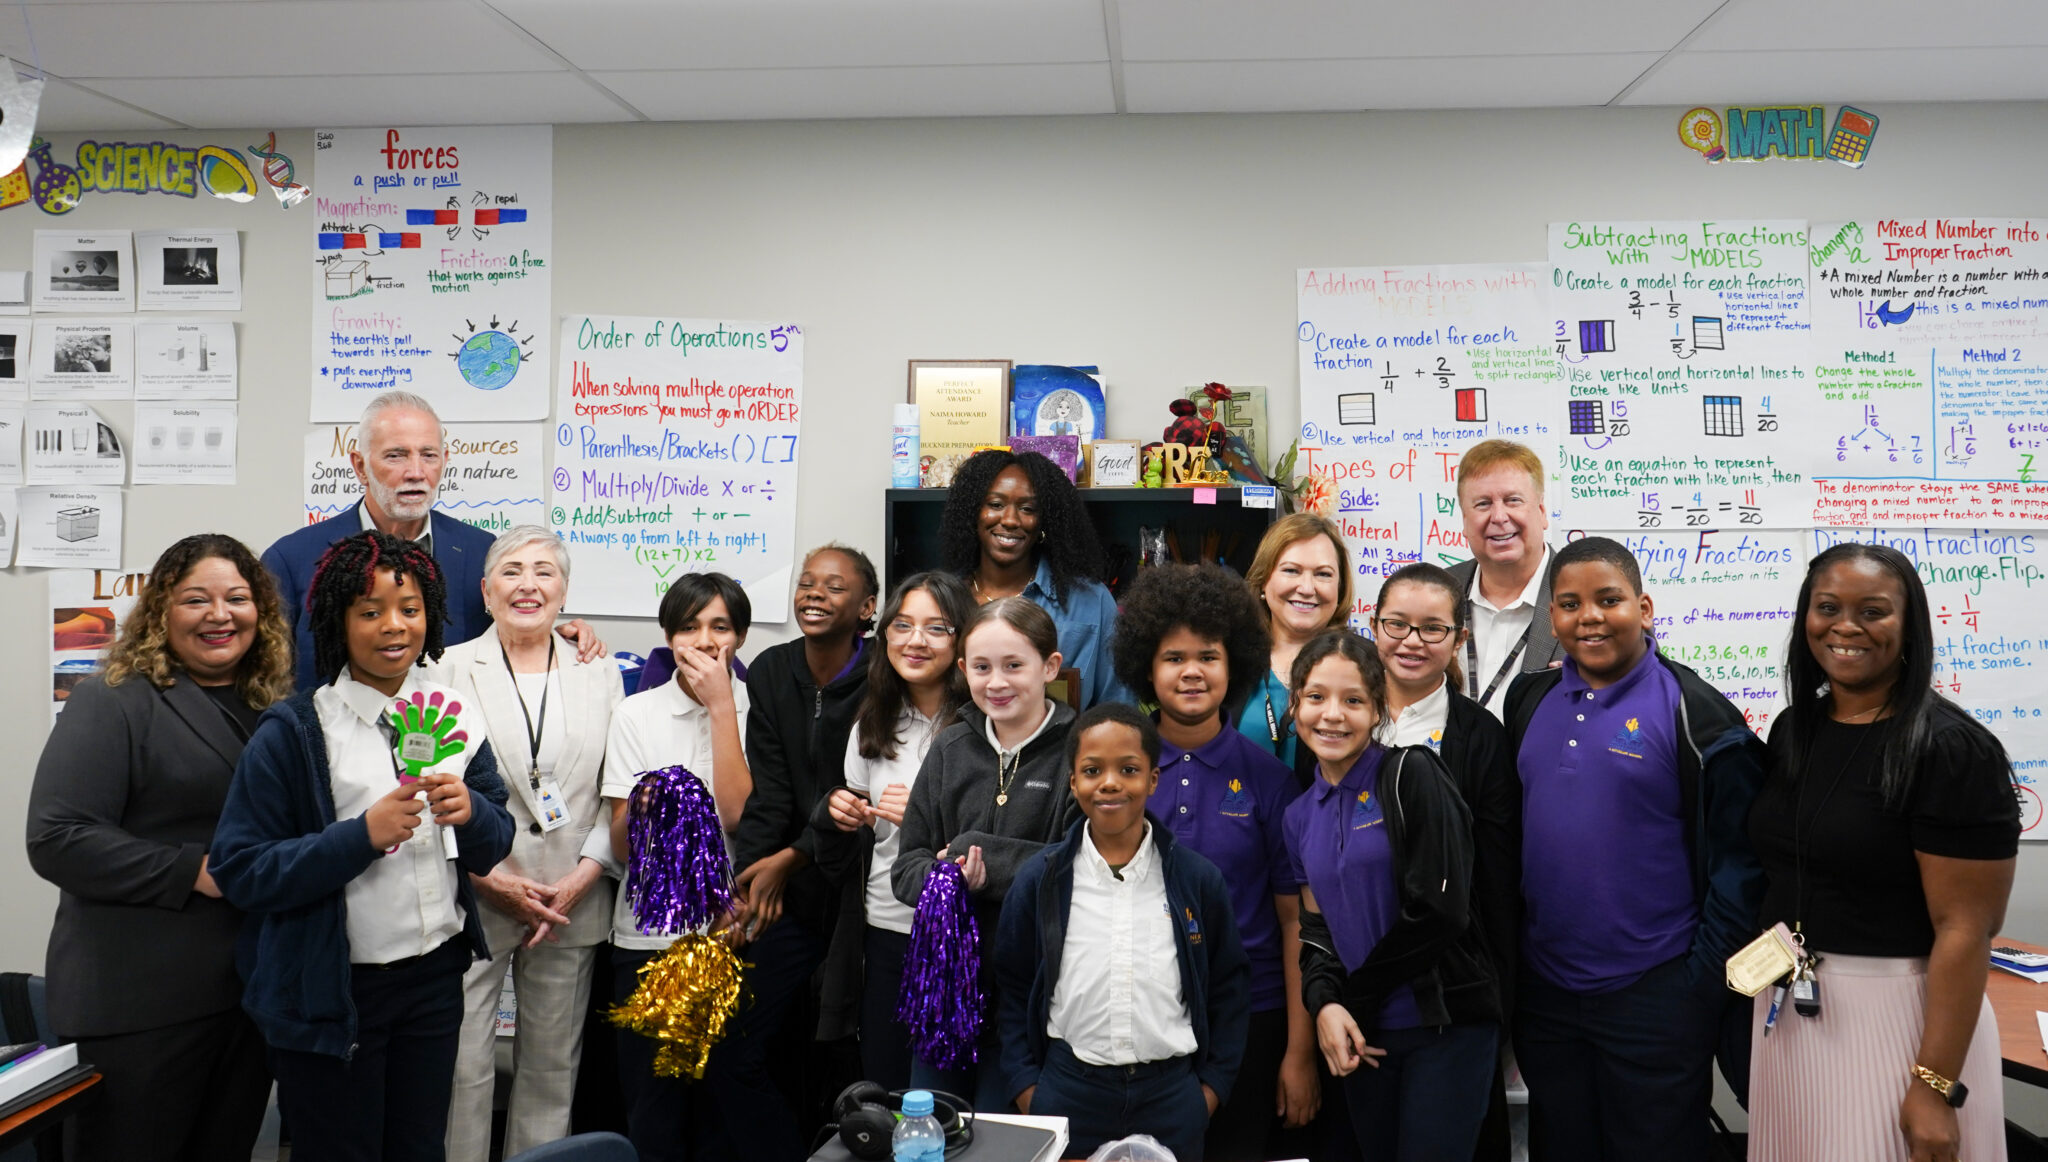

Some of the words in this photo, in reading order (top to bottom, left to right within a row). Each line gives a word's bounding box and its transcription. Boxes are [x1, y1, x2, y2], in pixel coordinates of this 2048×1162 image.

[1728, 107, 1824, 159] MATH
[380, 129, 459, 170] forces
[77, 140, 197, 198] SCIENCE
[354, 176, 363, 186] a
[374, 173, 405, 194] push
[414, 176, 426, 186] or
[433, 172, 461, 189] pull
[495, 194, 518, 205] repel
[317, 196, 399, 221] Magnetism:
[321, 223, 355, 232] Attract
[1877, 220, 1927, 238] Mixed
[1936, 220, 1998, 239] Number
[2008, 222, 2039, 242] into
[194, 236, 212, 244] Energy
[1564, 222, 1689, 261] Subtracting
[1702, 223, 1807, 248] Fractions
[441, 249, 507, 269] Friction:
[510, 255, 518, 267] a
[1691, 248, 1762, 269] MODELS
[1883, 243, 1950, 269] Improper
[1954, 243, 2012, 262] Fraction
[428, 269, 451, 283] that
[455, 271, 484, 281] works
[488, 269, 528, 286] against
[1302, 271, 1375, 296] Adding
[1383, 270, 1477, 294] Fractions
[1485, 270, 1537, 293] with
[1567, 272, 1613, 289] Create
[1621, 280, 1628, 288] a
[1637, 273, 1677, 289] model
[1683, 272, 1704, 289] for
[1708, 273, 1742, 291] each
[1746, 272, 1806, 291] fraction
[1845, 269, 1882, 284] mixed
[1887, 269, 1934, 283] Number
[1938, 270, 1947, 281] is
[1952, 274, 1959, 282] a
[1965, 269, 2008, 281] number
[376, 281, 404, 290] friction
[432, 283, 470, 293] motion
[330, 332, 350, 345] the
[353, 334, 389, 345] earth's
[395, 334, 412, 349] pull
[578, 318, 634, 350] Order
[645, 321, 664, 348] of
[671, 322, 767, 357] Operations
[1316, 332, 1371, 351] Create
[1376, 336, 1387, 347] a
[1393, 329, 1439, 346] model
[1448, 325, 1469, 345] for
[1473, 327, 1518, 344] each
[331, 348, 374, 357] towards
[382, 348, 396, 357] its
[399, 348, 432, 357] center
[1314, 353, 1372, 369] fraction
[1496, 347, 1551, 358] horizontal
[1845, 351, 1886, 363] Method
[1889, 351, 1896, 363] 1
[1963, 349, 2006, 362] Method
[2012, 349, 2021, 362] 2
[1472, 359, 1489, 368] and
[1492, 358, 1531, 368] vertical
[1535, 358, 1555, 367] lines
[334, 366, 355, 381] pulls
[359, 366, 412, 381] everything
[1474, 370, 1484, 380] to
[1488, 369, 1509, 382] split
[1569, 368, 1592, 381] Use
[1600, 366, 1653, 382] vertical
[1658, 366, 1680, 380] and
[1687, 365, 1754, 380] horizontal
[1762, 366, 1788, 378] lines
[1792, 366, 1805, 378] to
[342, 377, 395, 390] downward
[572, 361, 609, 399] When
[614, 376, 660, 407] solving
[666, 378, 725, 404] multiple
[729, 382, 794, 408] operation
[575, 403, 648, 425] expressions
[658, 403, 675, 424] you
[681, 403, 713, 420] must
[715, 408, 731, 428] go
[734, 408, 745, 419] in
[747, 401, 798, 423] ORDER
[1098, 455, 1133, 470] Good
[1390, 449, 1417, 482] of
[1571, 455, 1598, 471] Use
[1605, 461, 1623, 471] an
[1629, 457, 1687, 476] equation
[1694, 456, 1708, 469] to
[1716, 456, 1774, 473] represent
[742, 484, 755, 494] or
[1815, 480, 1835, 494] The
[1843, 480, 1915, 494] denominator
[1920, 481, 1953, 495] stays
[1960, 483, 1979, 492] the
[1987, 483, 2019, 493] SAME
[1339, 487, 1380, 506] Side:
[1437, 493, 1455, 516] by
[713, 511, 728, 521] or
[570, 531, 618, 549] Always
[622, 534, 636, 550] go
[641, 529, 670, 544] from
[677, 530, 701, 546] left
[708, 531, 719, 546] to
[1695, 530, 1792, 564] Fractions
[1925, 528, 2035, 555] Fractions
[1362, 547, 1378, 558] All
[1386, 549, 1393, 560] 3
[1397, 550, 1422, 561] sides
[1359, 564, 1378, 574] are
[1683, 608, 1698, 625] of
[1703, 608, 1723, 621] the
[1964, 635, 2031, 655] fraction
[1951, 657, 1977, 670] the
[1982, 657, 2032, 669] same.
[1743, 688, 1777, 700] Factor
[1975, 706, 2002, 723] sign
[2013, 706, 2026, 718] to
[2032, 709, 2041, 717] a
